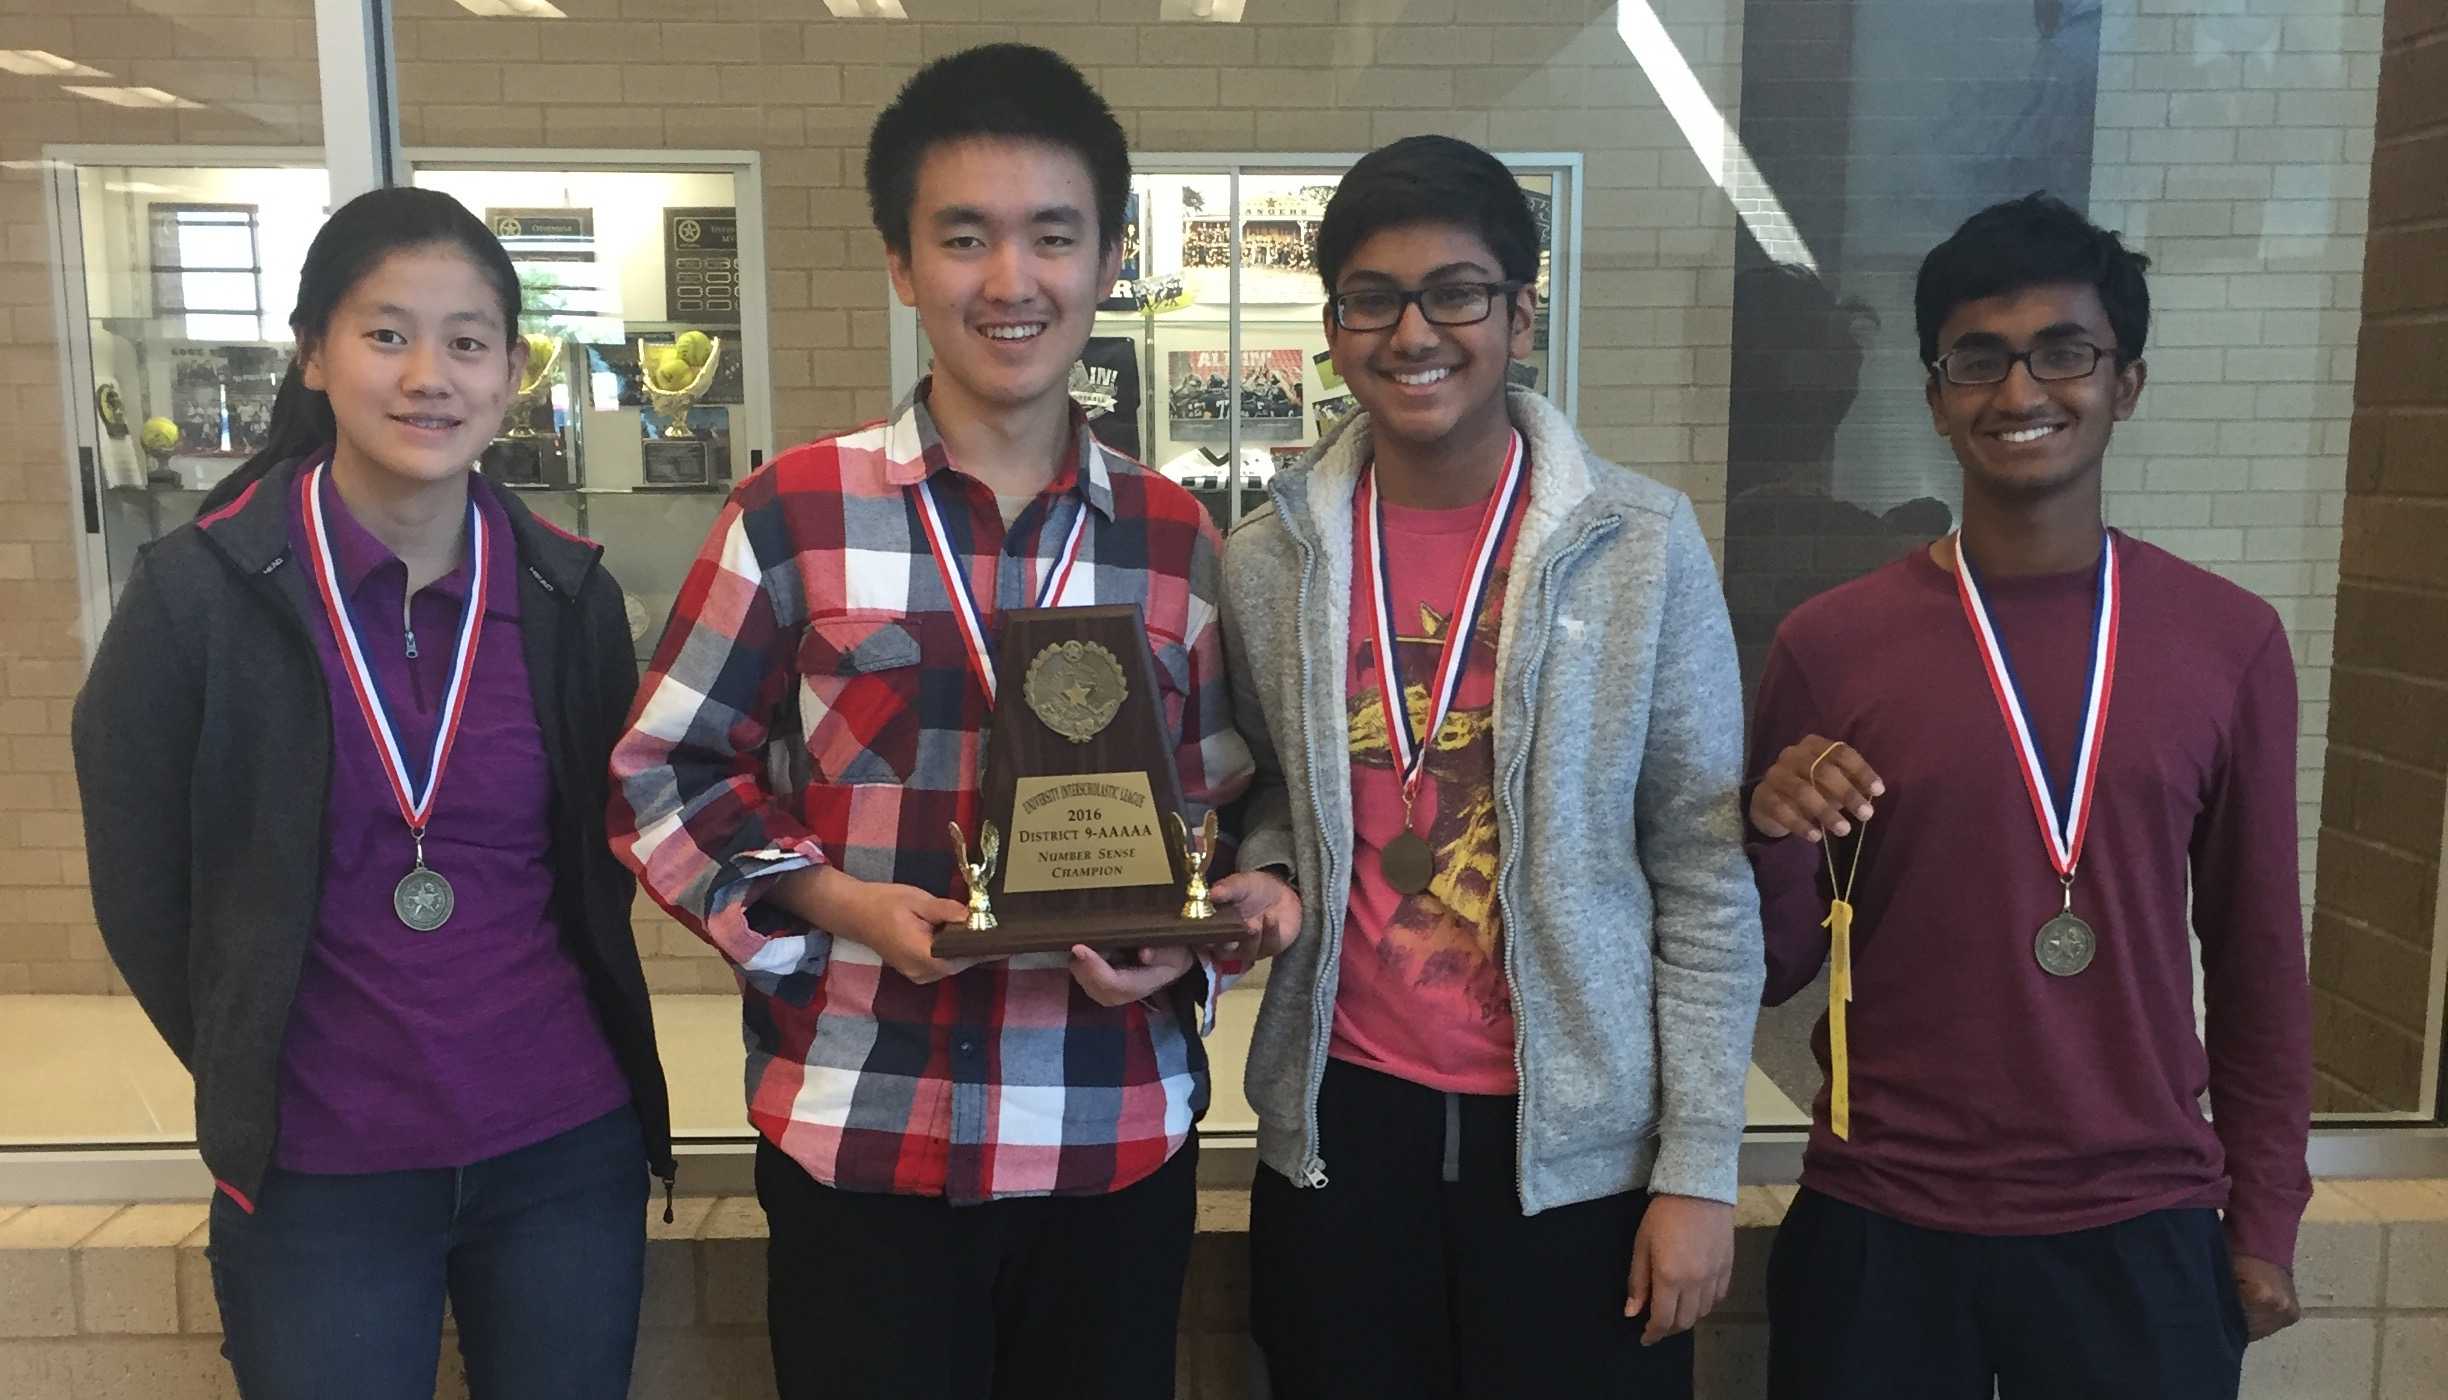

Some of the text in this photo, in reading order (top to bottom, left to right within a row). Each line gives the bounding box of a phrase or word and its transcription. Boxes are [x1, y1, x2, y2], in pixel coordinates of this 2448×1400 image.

[1022, 782, 1146, 814] UNIVERSITY INTERSCHOLASTIC LEAGUE
[1067, 808, 1102, 822] 2016
[1019, 824, 1152, 843] DISTRICT 9-AAAAA
[1038, 848, 1137, 862] NUMBER SENSE
[1051, 864, 1124, 879] CHAMPION
